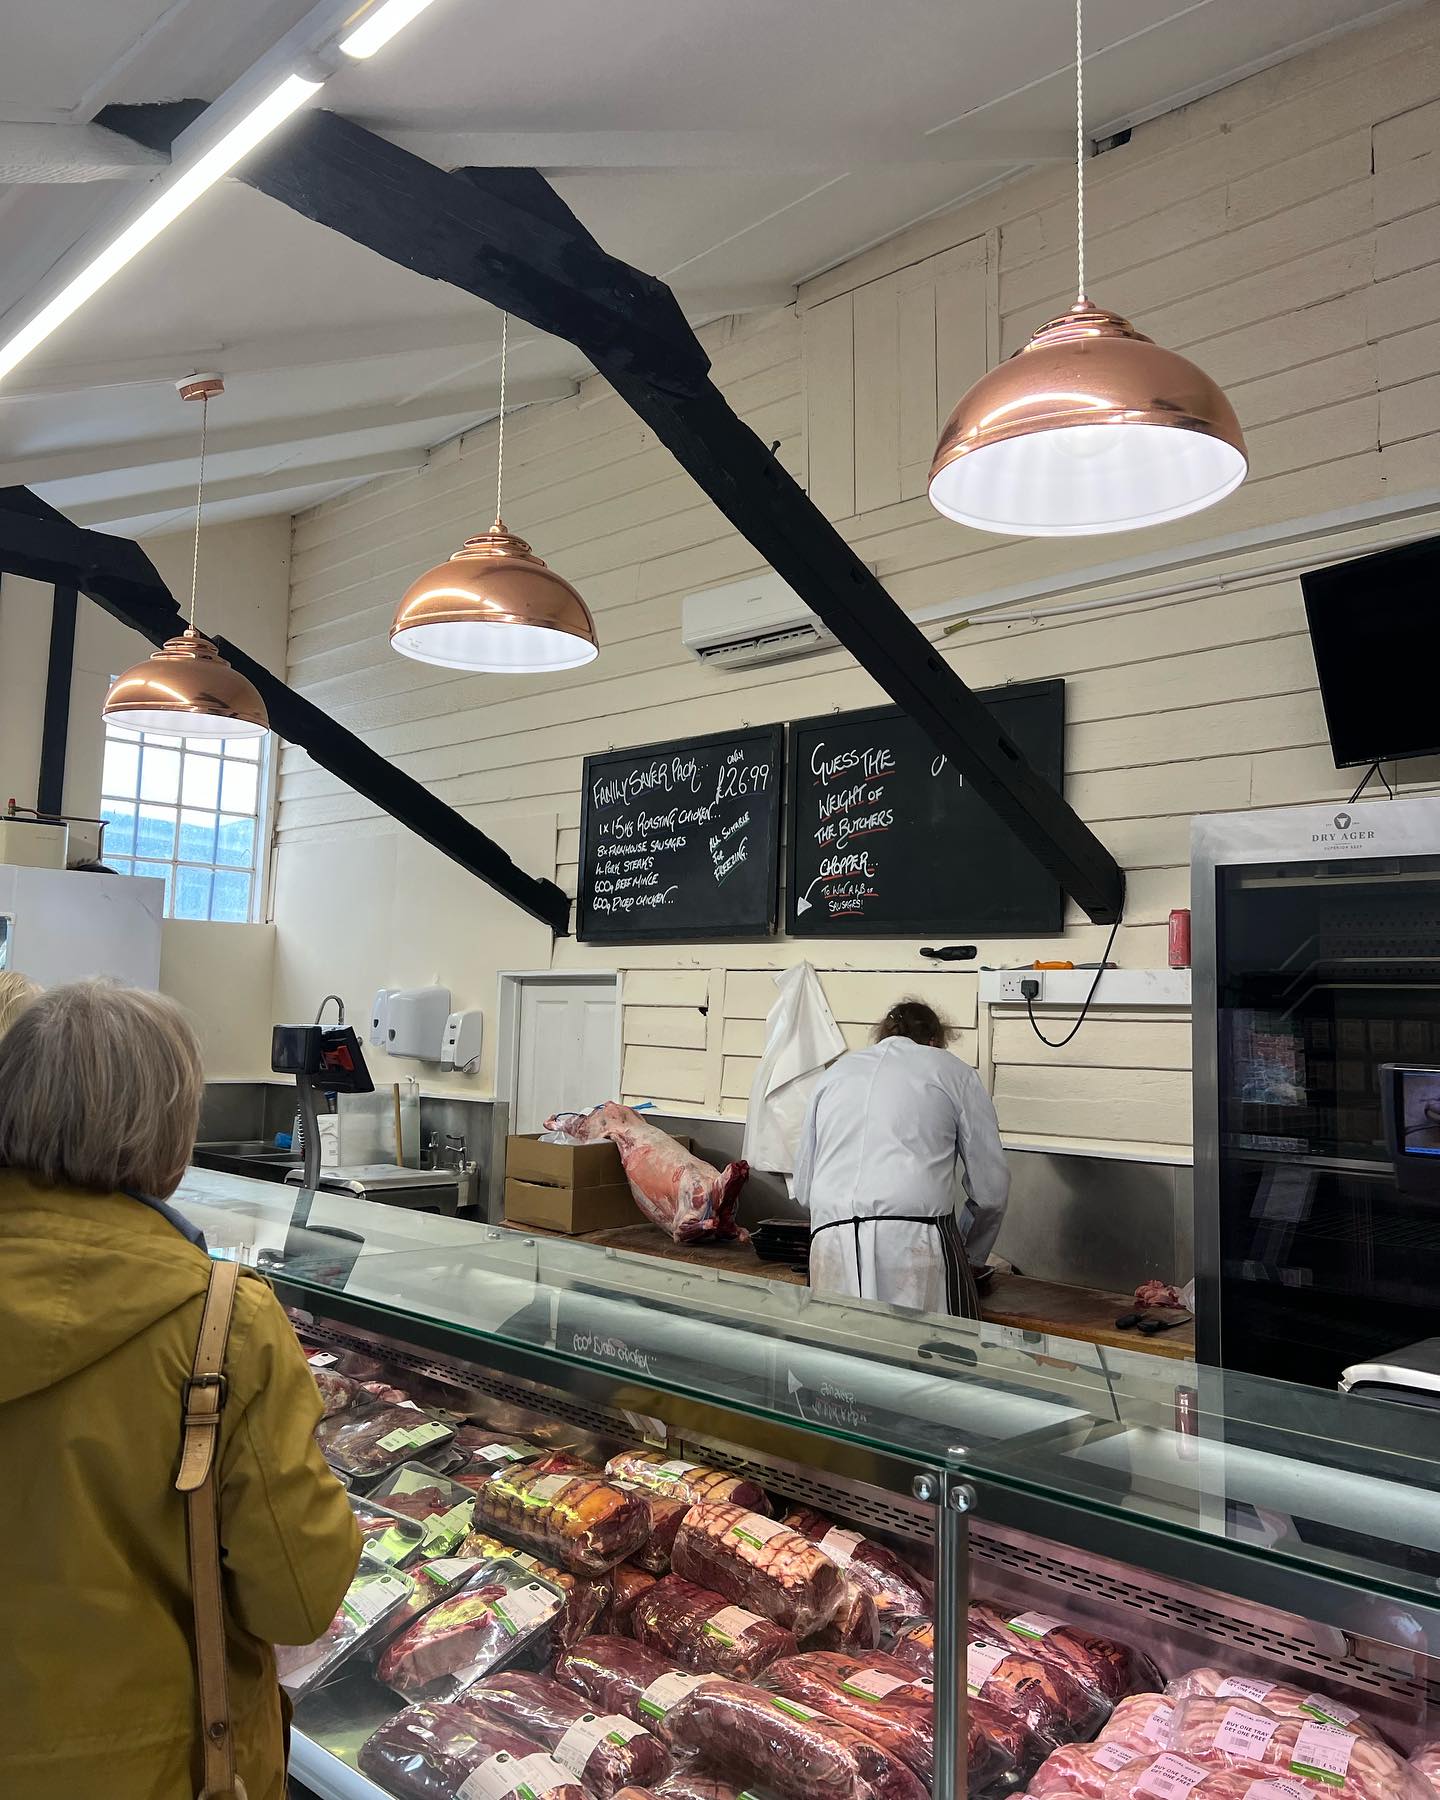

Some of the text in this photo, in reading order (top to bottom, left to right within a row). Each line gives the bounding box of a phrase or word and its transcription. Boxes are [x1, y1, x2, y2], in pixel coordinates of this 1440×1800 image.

[811, 742, 860, 786] GUESS
[860, 747, 896, 777] THE
[593, 777, 630, 809] FAMILY
[629, 761, 673, 795] SAVER
[819, 783, 884, 819] WEIGHT OF
[814, 808, 894, 850] THE BUTCHERS
[1312, 830, 1375, 842] DRY AGER
[650, 836, 687, 852] SAUSAGES
[623, 856, 654, 873] STEAKS
[594, 871, 659, 894] 600g BEEF MINCE
[592, 896, 611, 915] 600g
[1226, 1721, 1270, 1738] BUY ONE TRAY
[1236, 1730, 1250, 1738] ONE
[1250, 1734, 1267, 1743] FREE
[1162, 1772, 1176, 1780] ONE
[1175, 1777, 1191, 1787] FREE
[1166, 1768, 1179, 1776] ONE
[1180, 1774, 1196, 1783] TRAY
